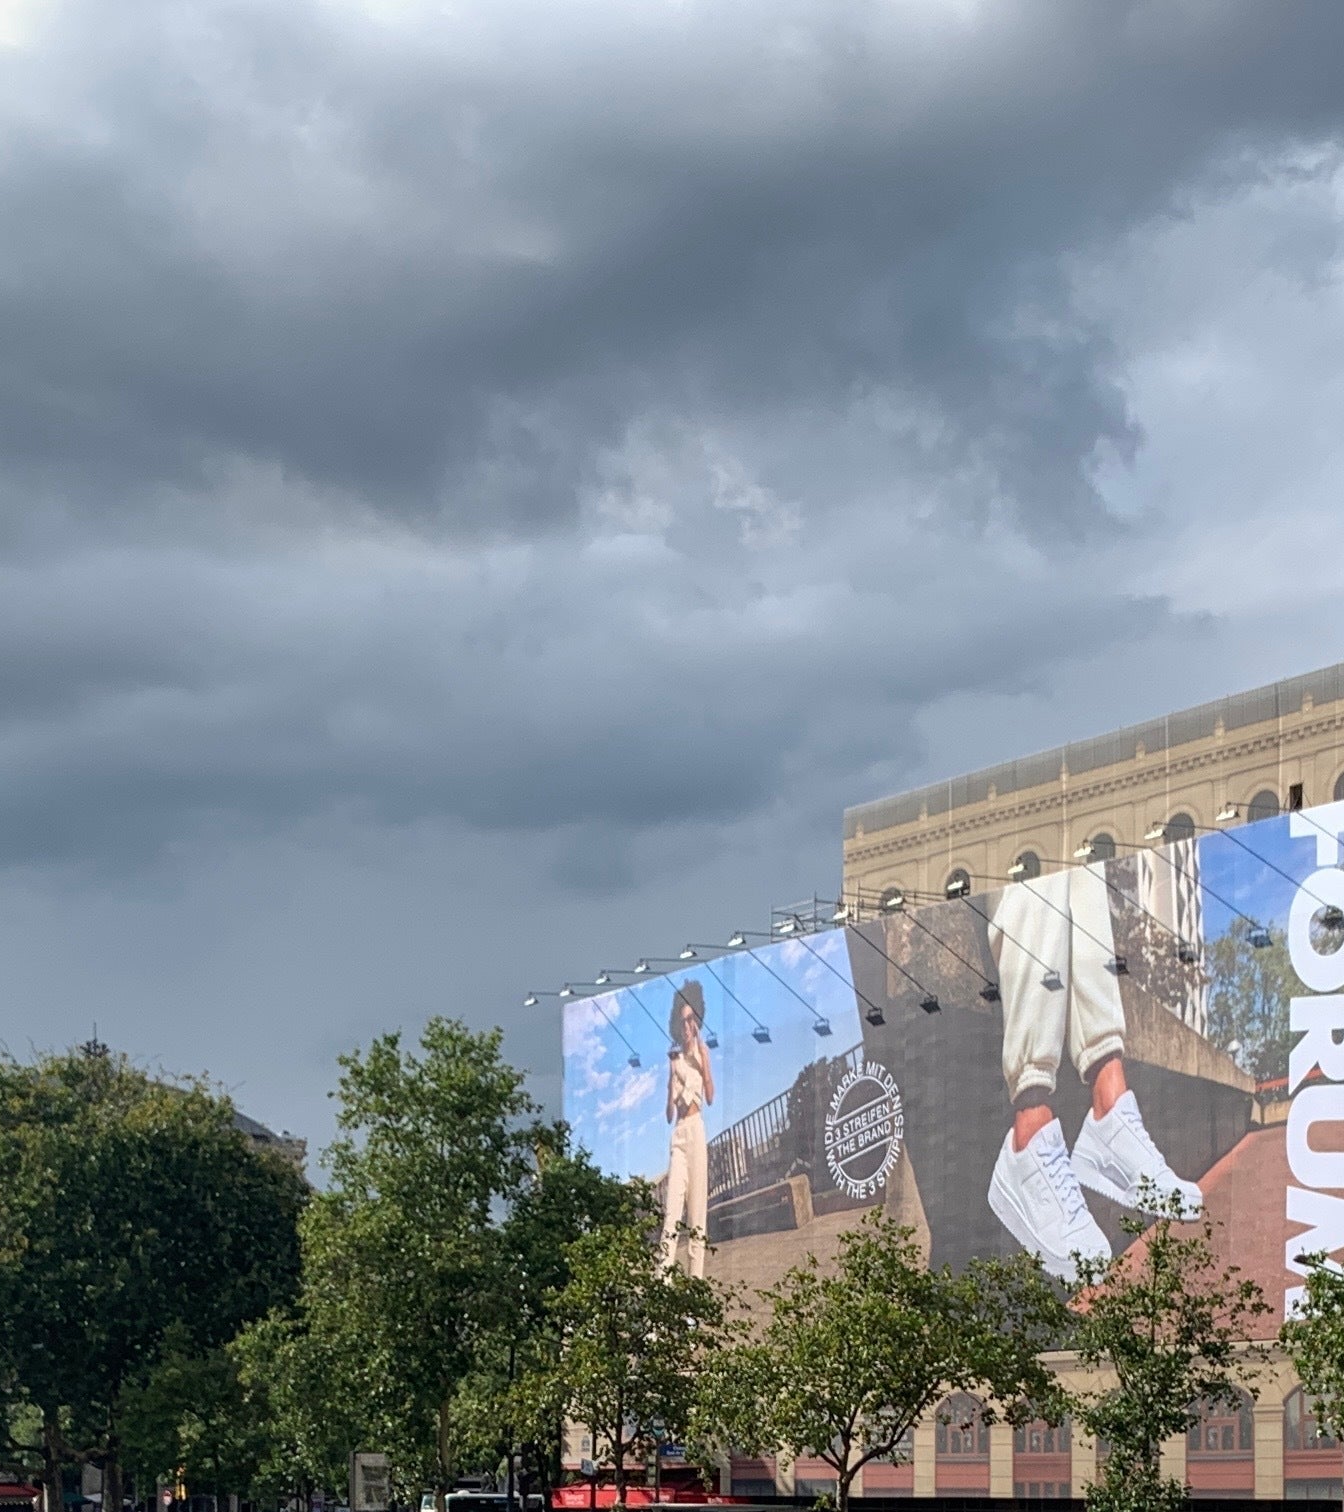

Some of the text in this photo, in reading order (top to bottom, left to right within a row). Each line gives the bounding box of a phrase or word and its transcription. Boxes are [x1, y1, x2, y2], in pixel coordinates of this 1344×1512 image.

[825, 1061, 902, 1145] DIE MARKE MIT DEN
[834, 1102, 890, 1141] 3 STREIFEN
[826, 1113, 905, 1200] WITH THE 3 STRIPES
[836, 1121, 892, 1158] THE BRAND
